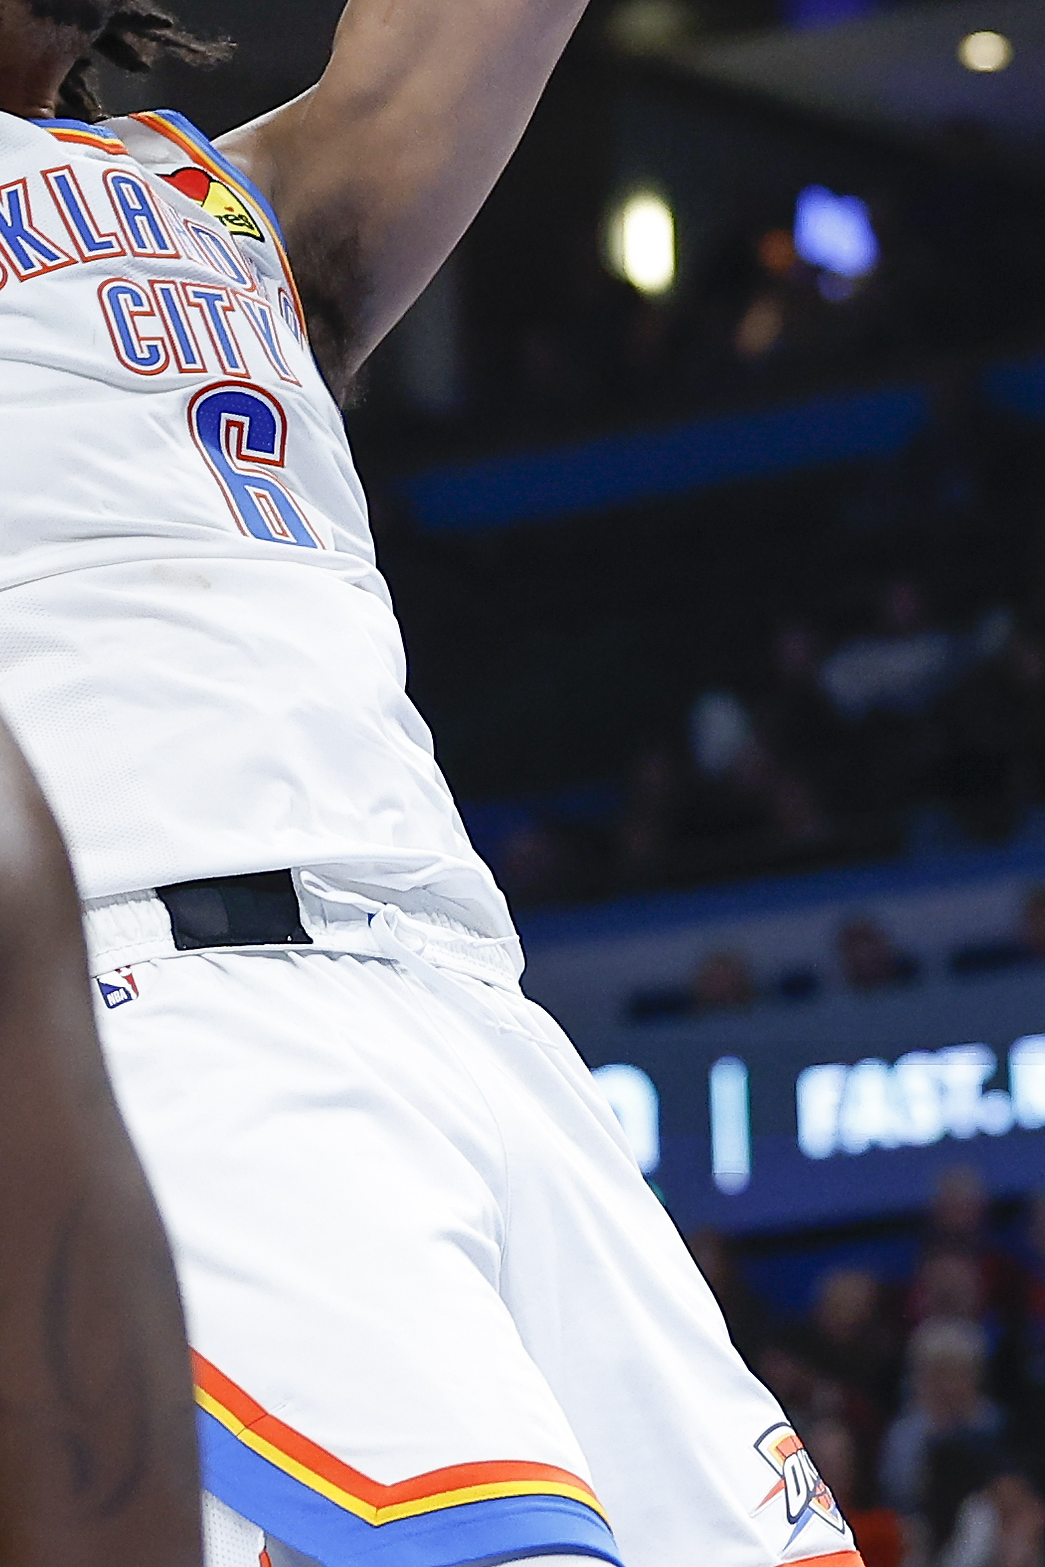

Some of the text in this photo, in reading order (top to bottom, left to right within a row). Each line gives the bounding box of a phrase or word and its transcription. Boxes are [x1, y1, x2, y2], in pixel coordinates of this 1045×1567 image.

[98, 276, 301, 387] CITY
[187, 380, 326, 551] 6
[106, 988, 129, 1007] NBA
